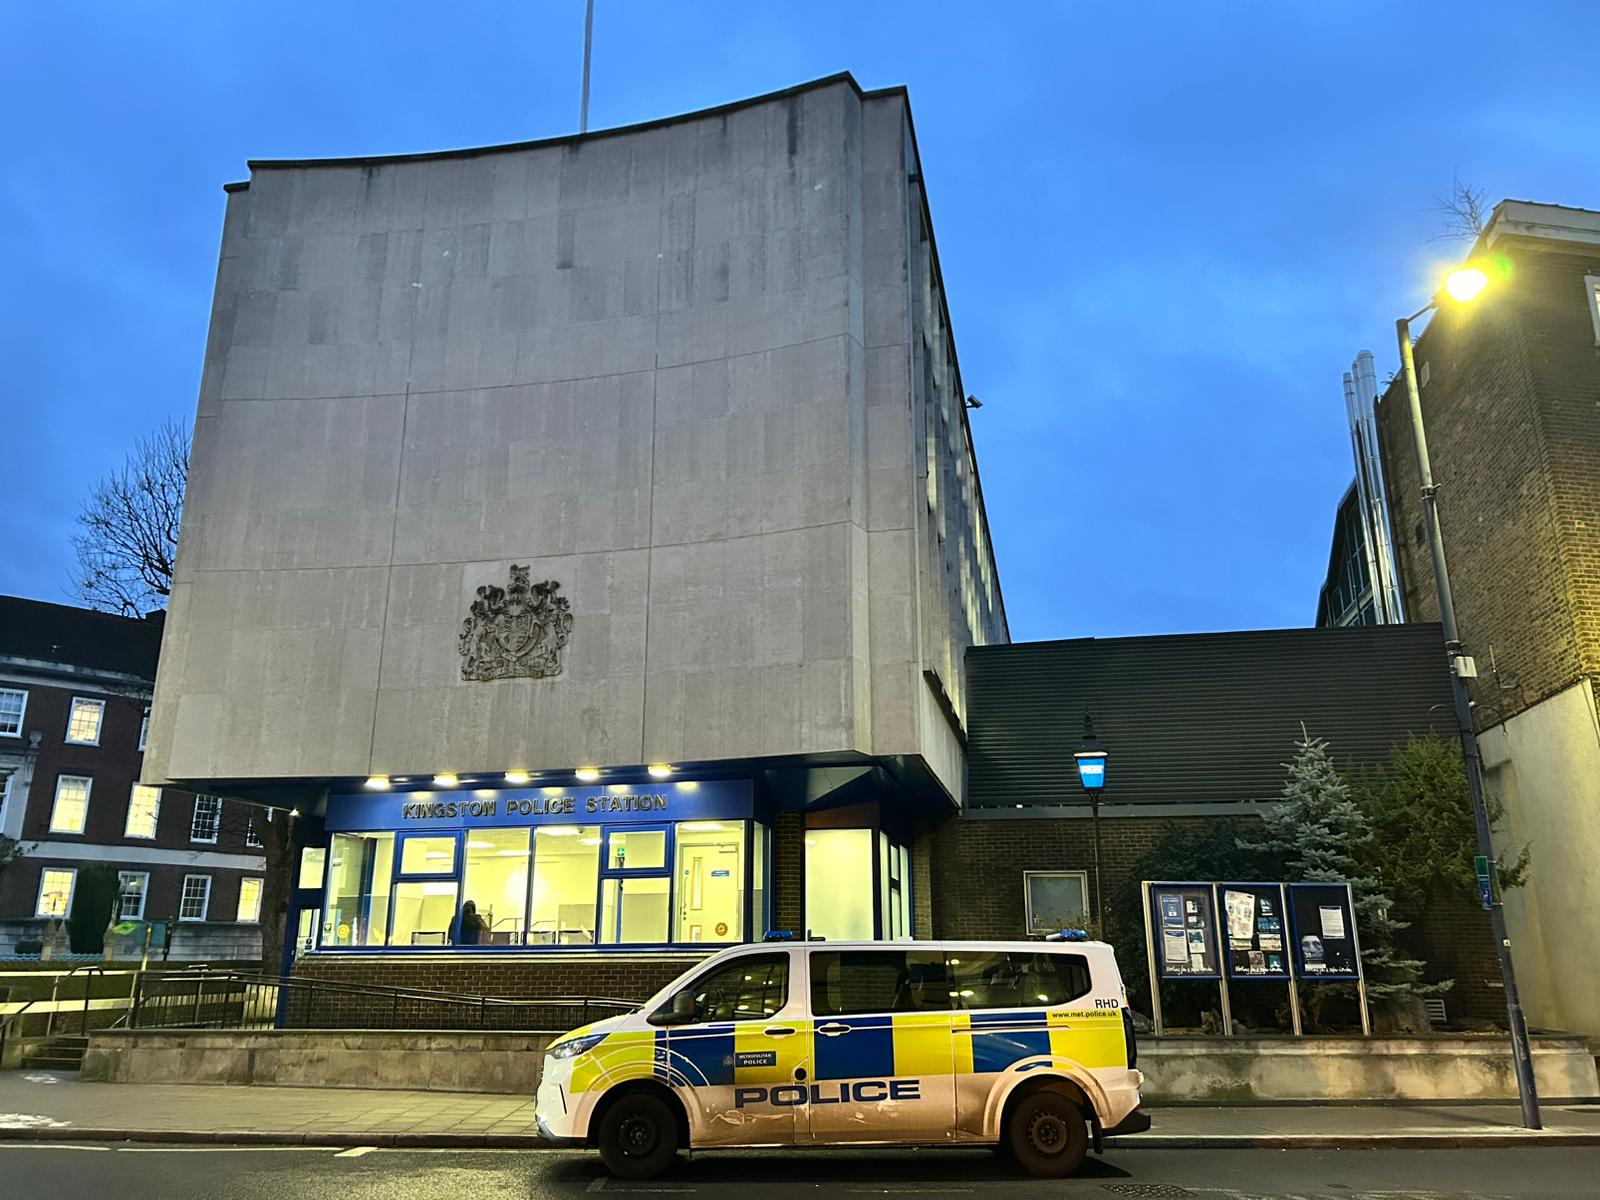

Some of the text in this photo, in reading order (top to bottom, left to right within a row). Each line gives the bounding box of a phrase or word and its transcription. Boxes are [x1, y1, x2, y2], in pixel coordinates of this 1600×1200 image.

[402, 794, 668, 819] KINGSTON POLICE STATION
[1094, 999, 1119, 1009] RHD
[1052, 1010, 1117, 1018] www.met.police.uk
[734, 1079, 921, 1108] POLICE
